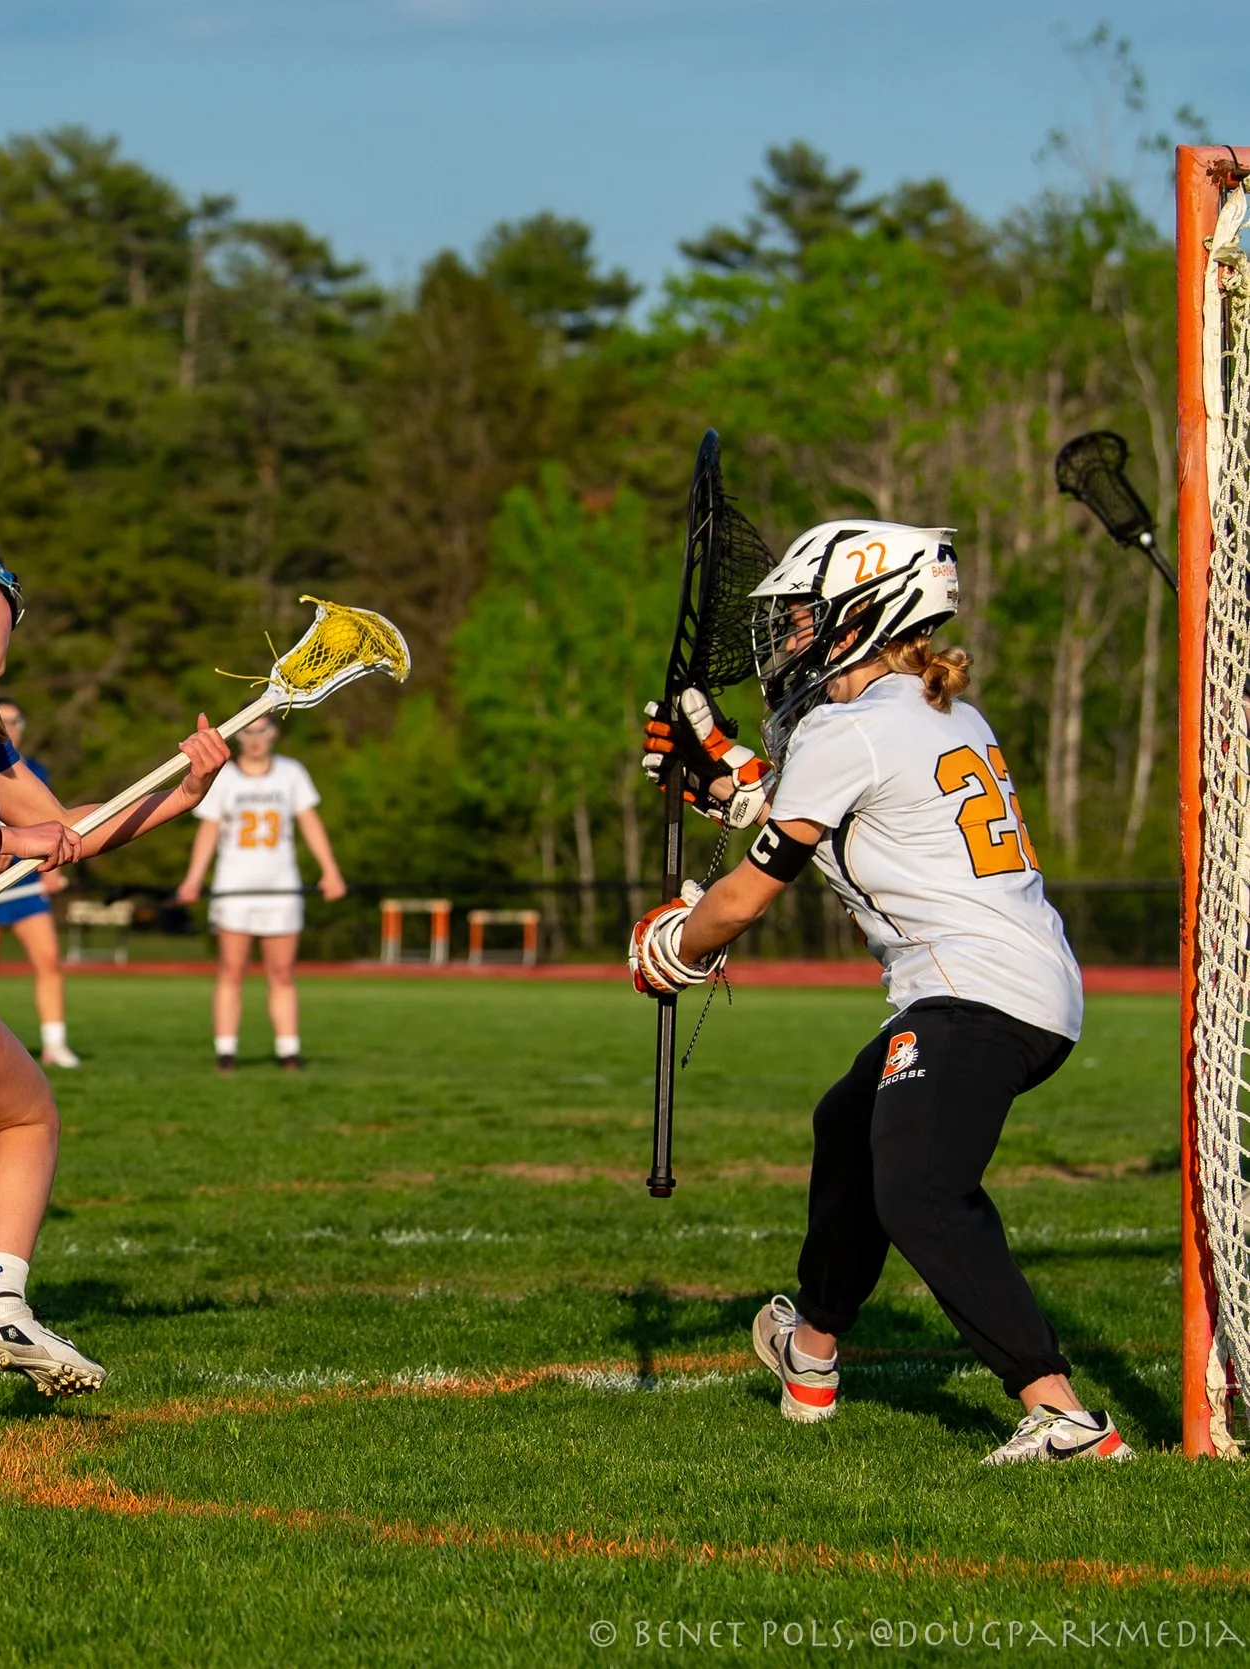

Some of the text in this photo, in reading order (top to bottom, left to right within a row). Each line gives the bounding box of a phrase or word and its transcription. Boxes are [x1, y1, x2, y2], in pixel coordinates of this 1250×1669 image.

[846, 541, 891, 584] 22
[239, 810, 281, 849] 23
[750, 823, 780, 865] C
[877, 1069, 926, 1090] CROSSE
